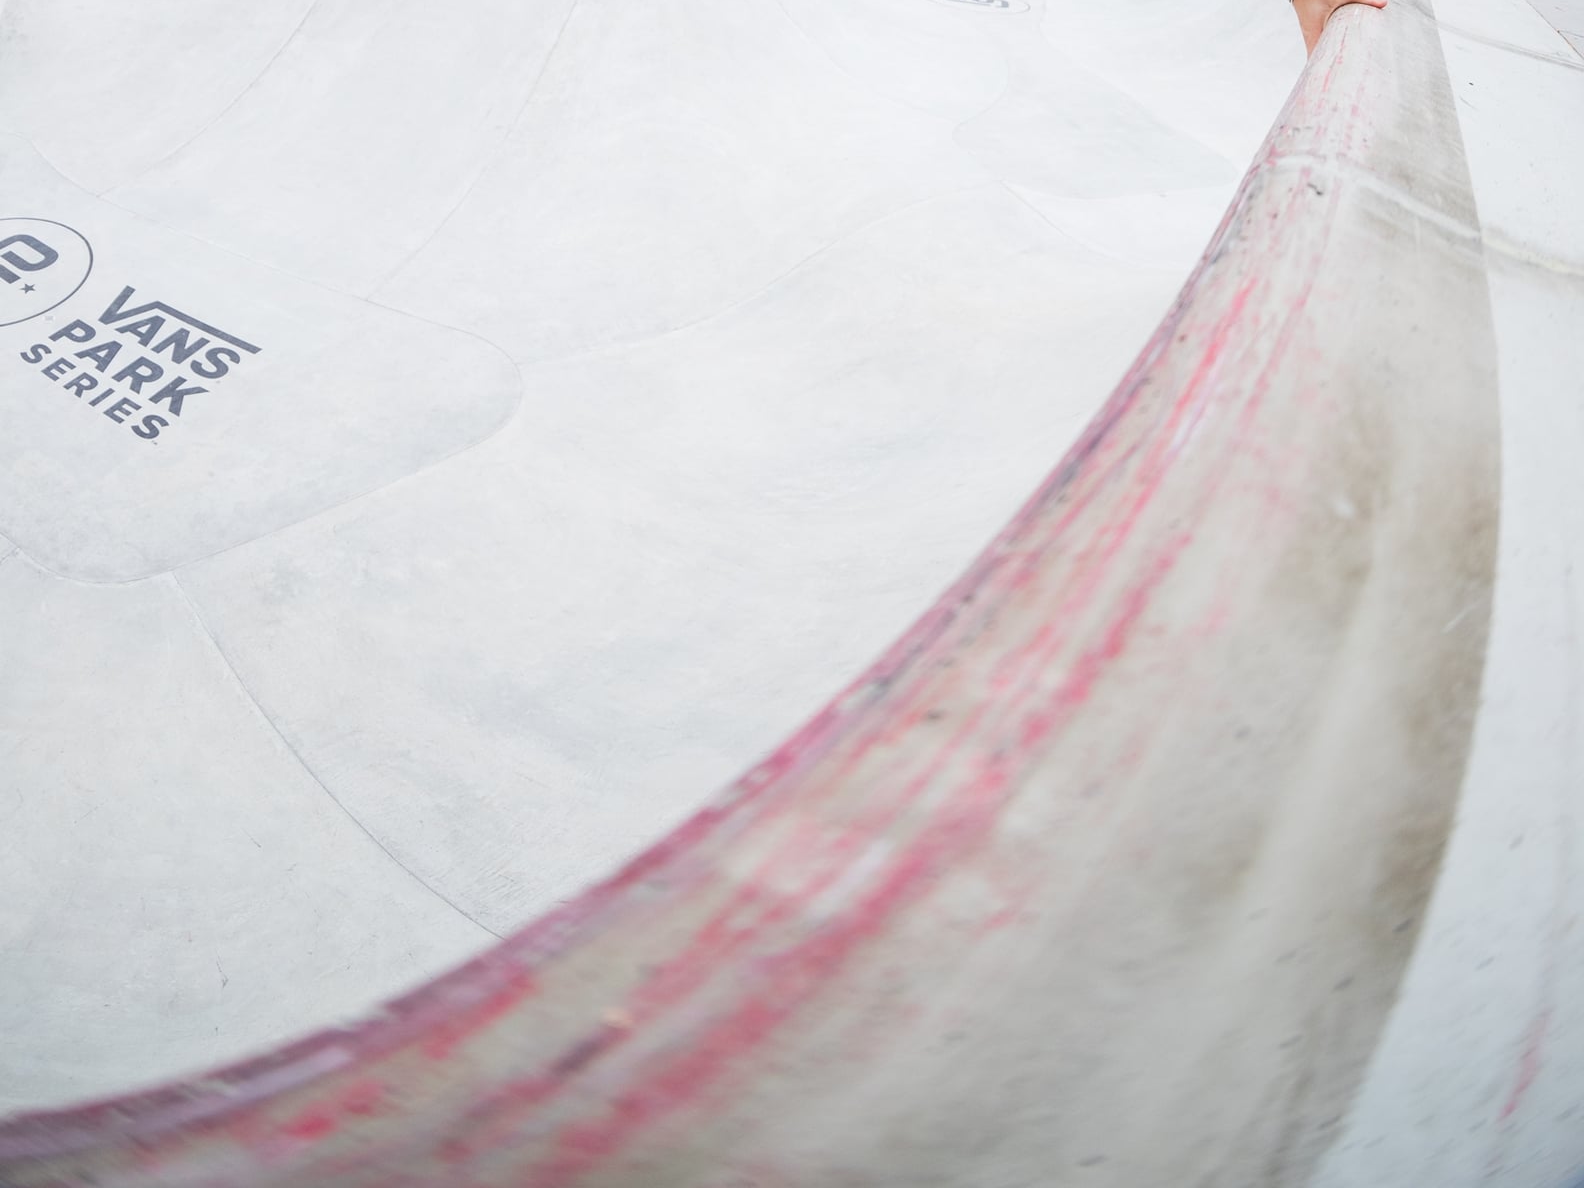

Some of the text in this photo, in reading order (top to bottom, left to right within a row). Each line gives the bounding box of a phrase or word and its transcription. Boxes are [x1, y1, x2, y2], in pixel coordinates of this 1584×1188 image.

[48, 319, 209, 417] PARK
[98, 285, 262, 380] VANS
[20, 343, 170, 440] SERIES
